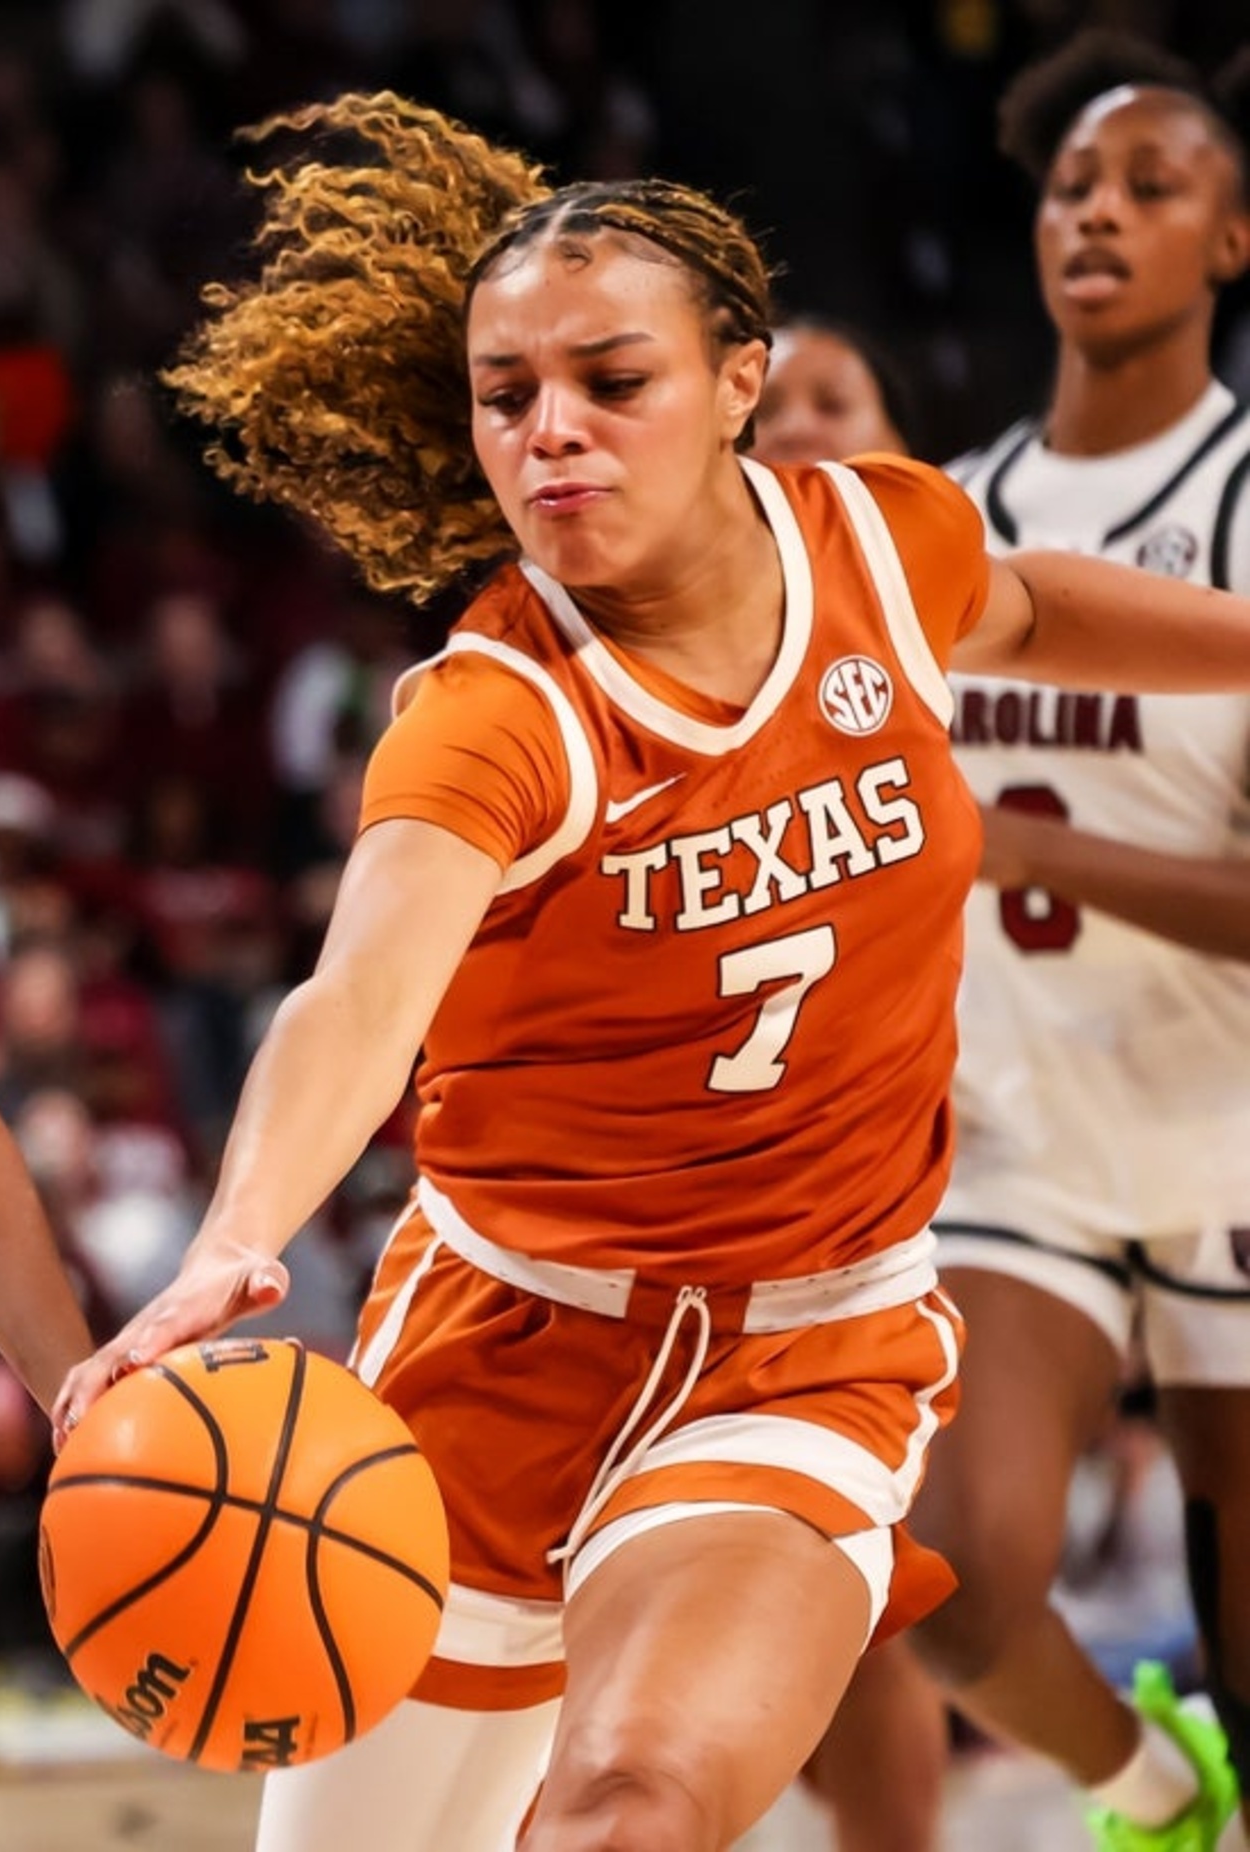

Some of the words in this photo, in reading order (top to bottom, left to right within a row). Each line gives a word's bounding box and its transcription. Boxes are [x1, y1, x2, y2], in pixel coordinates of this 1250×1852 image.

[824, 660, 889, 731] SEC
[950, 689, 1143, 756] ROLINA
[600, 756, 926, 932] TEXAS
[705, 922, 839, 1094] 7
